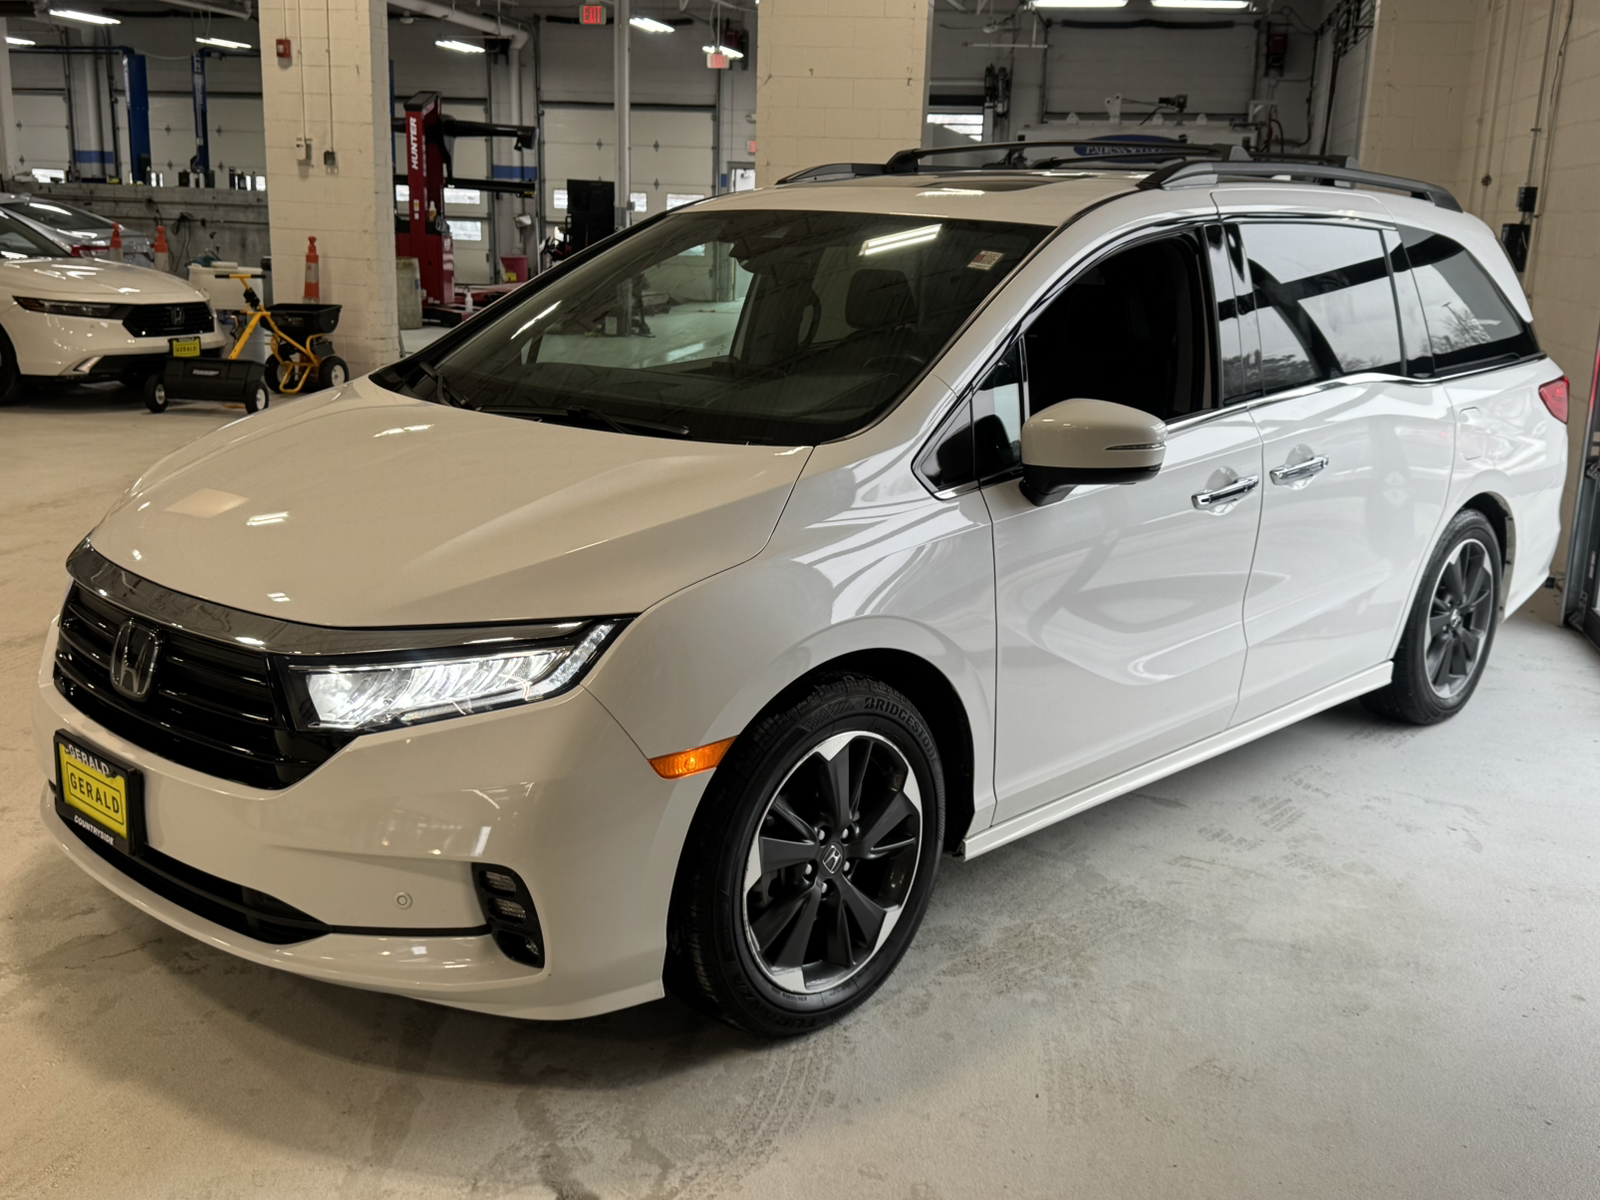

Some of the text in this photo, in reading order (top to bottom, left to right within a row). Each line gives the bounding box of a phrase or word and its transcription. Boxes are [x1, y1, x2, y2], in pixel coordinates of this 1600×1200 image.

[584, 6, 602, 24] EXIT
[410, 116, 419, 170] HUNTER
[864, 697, 938, 768] BRIDGESTONE
[68, 744, 110, 775] GERALD
[69, 772, 121, 815] GERALD
[74, 815, 115, 846] COUNTRYSIDE
